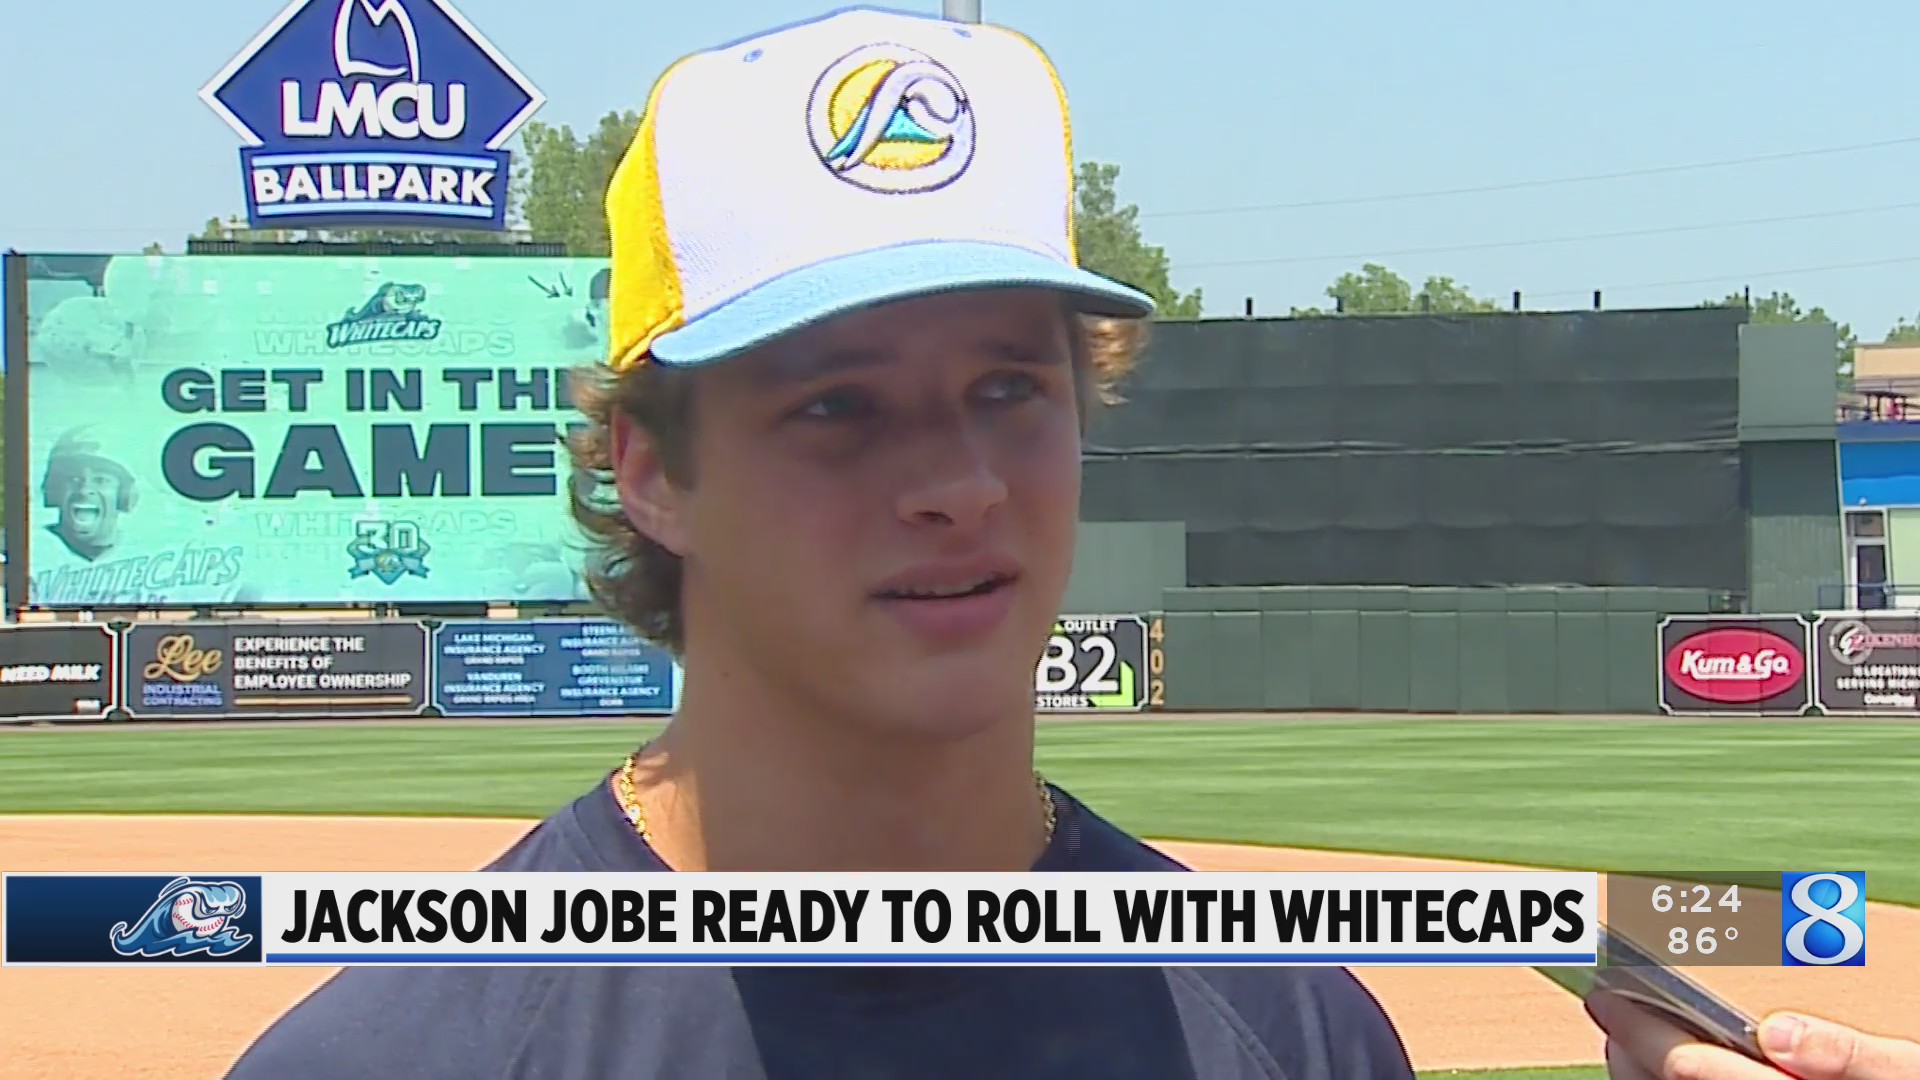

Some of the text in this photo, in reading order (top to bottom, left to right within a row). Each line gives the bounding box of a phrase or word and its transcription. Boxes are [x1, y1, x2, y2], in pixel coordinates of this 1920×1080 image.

[282, 81, 466, 139] LMCU
[253, 165, 496, 205] BALLPARK
[327, 319, 441, 347] WHITECAPS
[162, 367, 323, 413] GET
[346, 367, 422, 412] IN
[162, 421, 588, 502] GAME
[356, 520, 420, 554] 30
[1063, 620, 1116, 633] OUTLET
[234, 637, 365, 652] EXPERIENCE THE
[454, 633, 535, 643] LAKE MICHIGAN
[560, 637, 618, 649] INSURANCE
[443, 644, 546, 655] INSURANCE AGENCY
[143, 634, 224, 683] Lee
[234, 655, 334, 670] BENEFITS OF
[50, 663, 102, 681] MILK
[1863, 664, 1920, 677] LOCATION
[143, 683, 223, 695] INDUSTRIAL
[234, 673, 412, 690] EMPLOYEE OWNERSHIP
[443, 682, 546, 694] INSURANCE AGENCY
[560, 686, 661, 698] INSURANCE AGENCY
[143, 696, 223, 707] CONTRACTING
[1036, 695, 1089, 708] STORES
